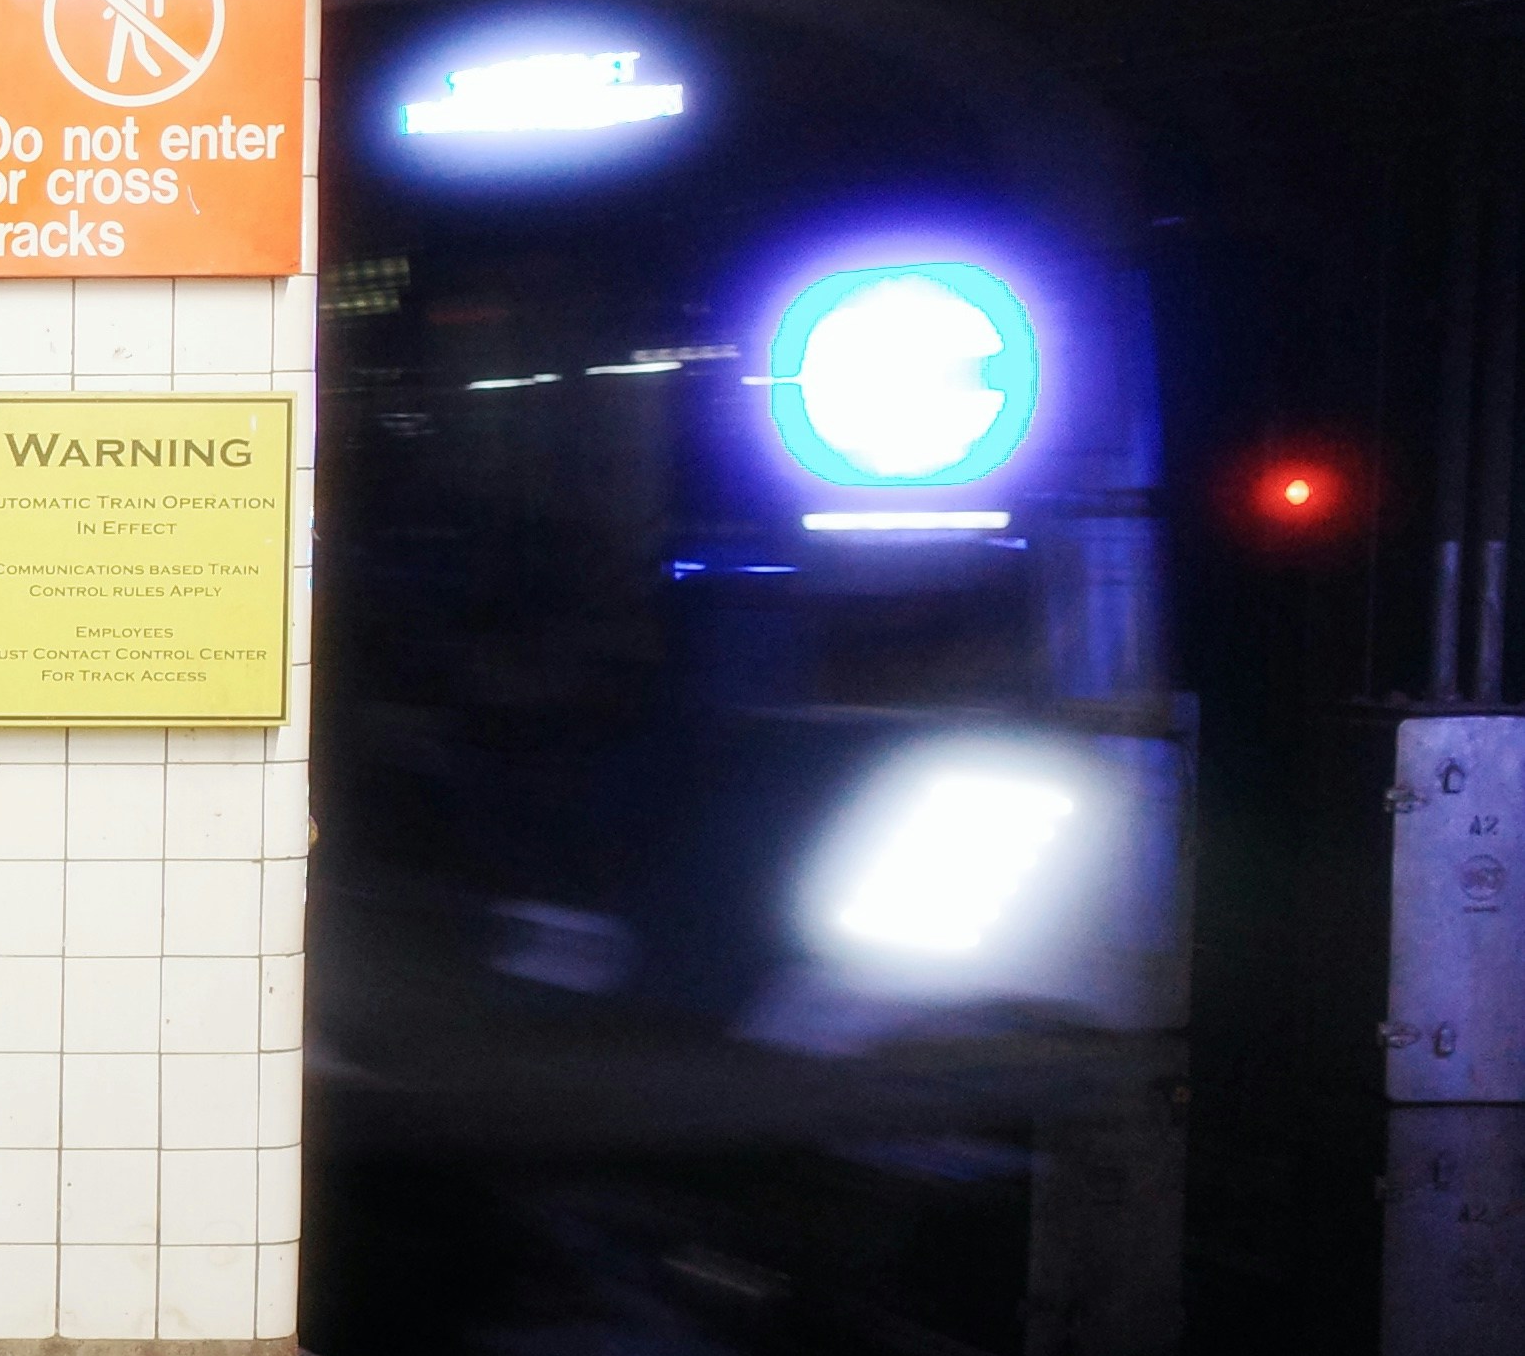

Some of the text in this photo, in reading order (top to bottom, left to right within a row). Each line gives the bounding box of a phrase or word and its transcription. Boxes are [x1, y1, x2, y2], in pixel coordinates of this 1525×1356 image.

[64, 116, 139, 162] not
[160, 115, 285, 161] enter
[46, 166, 179, 205] cross
[3, 433, 253, 468] WARNING
[97, 495, 157, 510] TRAIN
[162, 495, 275, 510] OPERATION
[77, 520, 178, 536] IN EFFECT
[149, 564, 204, 576] BASED
[208, 563, 260, 576] TRAIN
[29, 585, 222, 597] CONTROL RULES APPLY
[76, 626, 174, 639] EMPLOYEES
[32, 648, 111, 661] CONTACT
[115, 648, 194, 661] CONTROL
[199, 648, 267, 661] CENTER
[41, 669, 207, 682] FOR TRACK ACCESS
